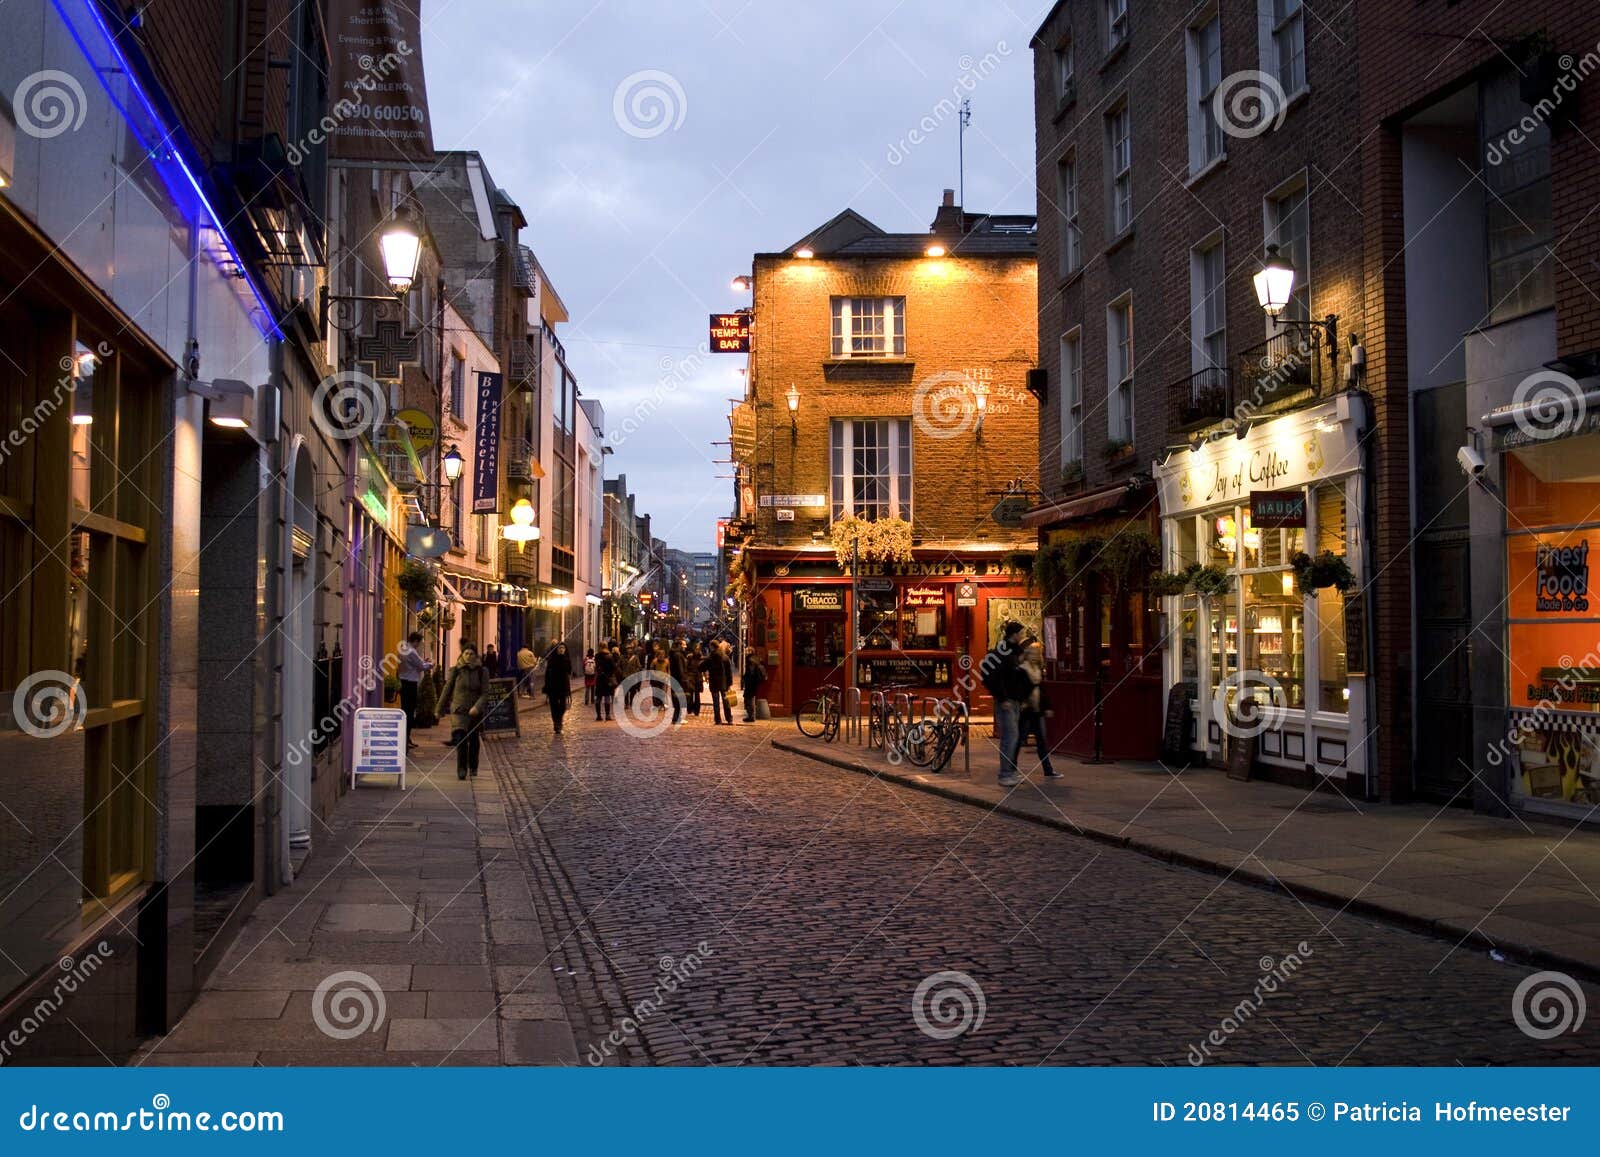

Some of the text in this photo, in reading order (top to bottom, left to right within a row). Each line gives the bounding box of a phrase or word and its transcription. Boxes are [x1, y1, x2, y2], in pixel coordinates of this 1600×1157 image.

[349, 16, 374, 25] Short
[338, 34, 375, 46] Evening
[334, 125, 425, 140] irishfilmacademy.com
[720, 317, 739, 327] THE
[710, 328, 749, 338] TEMPLE
[720, 339, 740, 349] BAR
[962, 367, 993, 380] THE
[998, 383, 1027, 406] BAR
[479, 376, 498, 498] Botticelli RESTAURANT
[1206, 449, 1289, 501] Joy of Coffee
[1537, 540, 1588, 568] Finest
[843, 562, 885, 577] THE
[892, 562, 977, 576] TEMPLE
[1537, 568, 1588, 597] Food
[800, 594, 837, 608] TOBACCO
[1537, 598, 1561, 611] Made
[1574, 598, 1588, 611] Go
[1019, 609, 1037, 618] BAR
